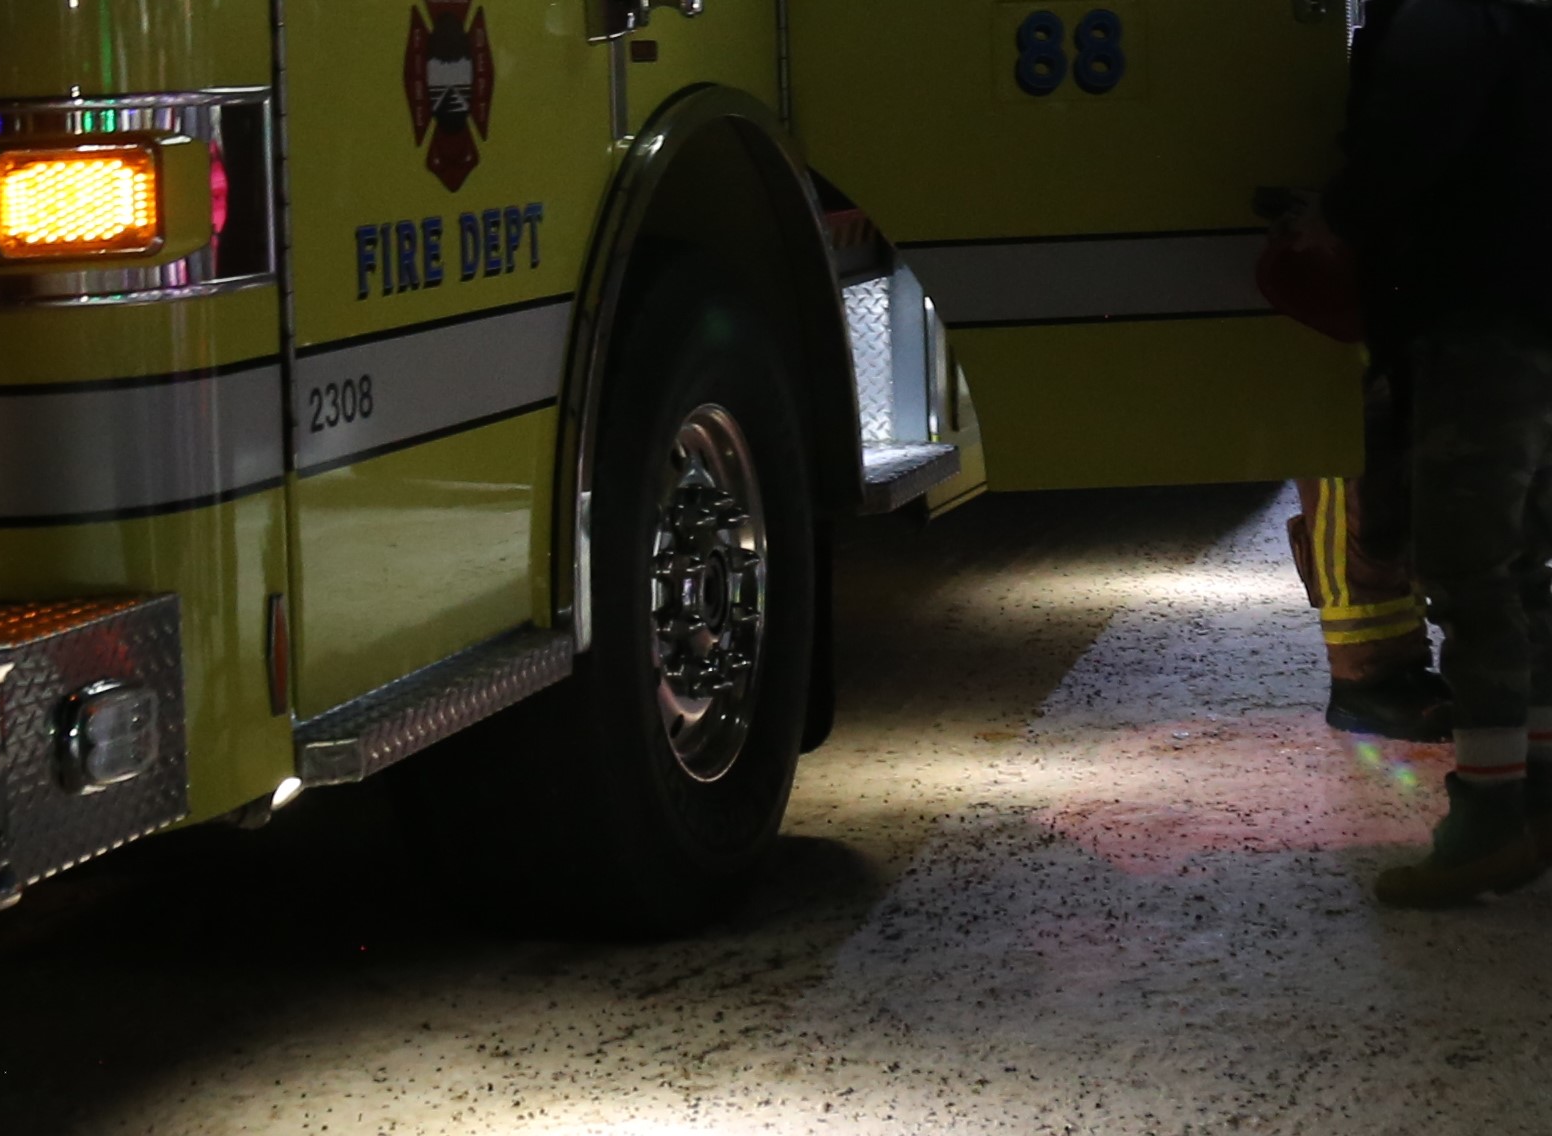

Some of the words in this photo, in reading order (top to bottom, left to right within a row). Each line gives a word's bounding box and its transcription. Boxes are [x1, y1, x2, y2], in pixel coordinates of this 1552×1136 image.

[1016, 9, 1124, 96] 88
[354, 216, 443, 300] FIRE
[459, 202, 544, 282] DEPT
[310, 374, 373, 433] 2308
